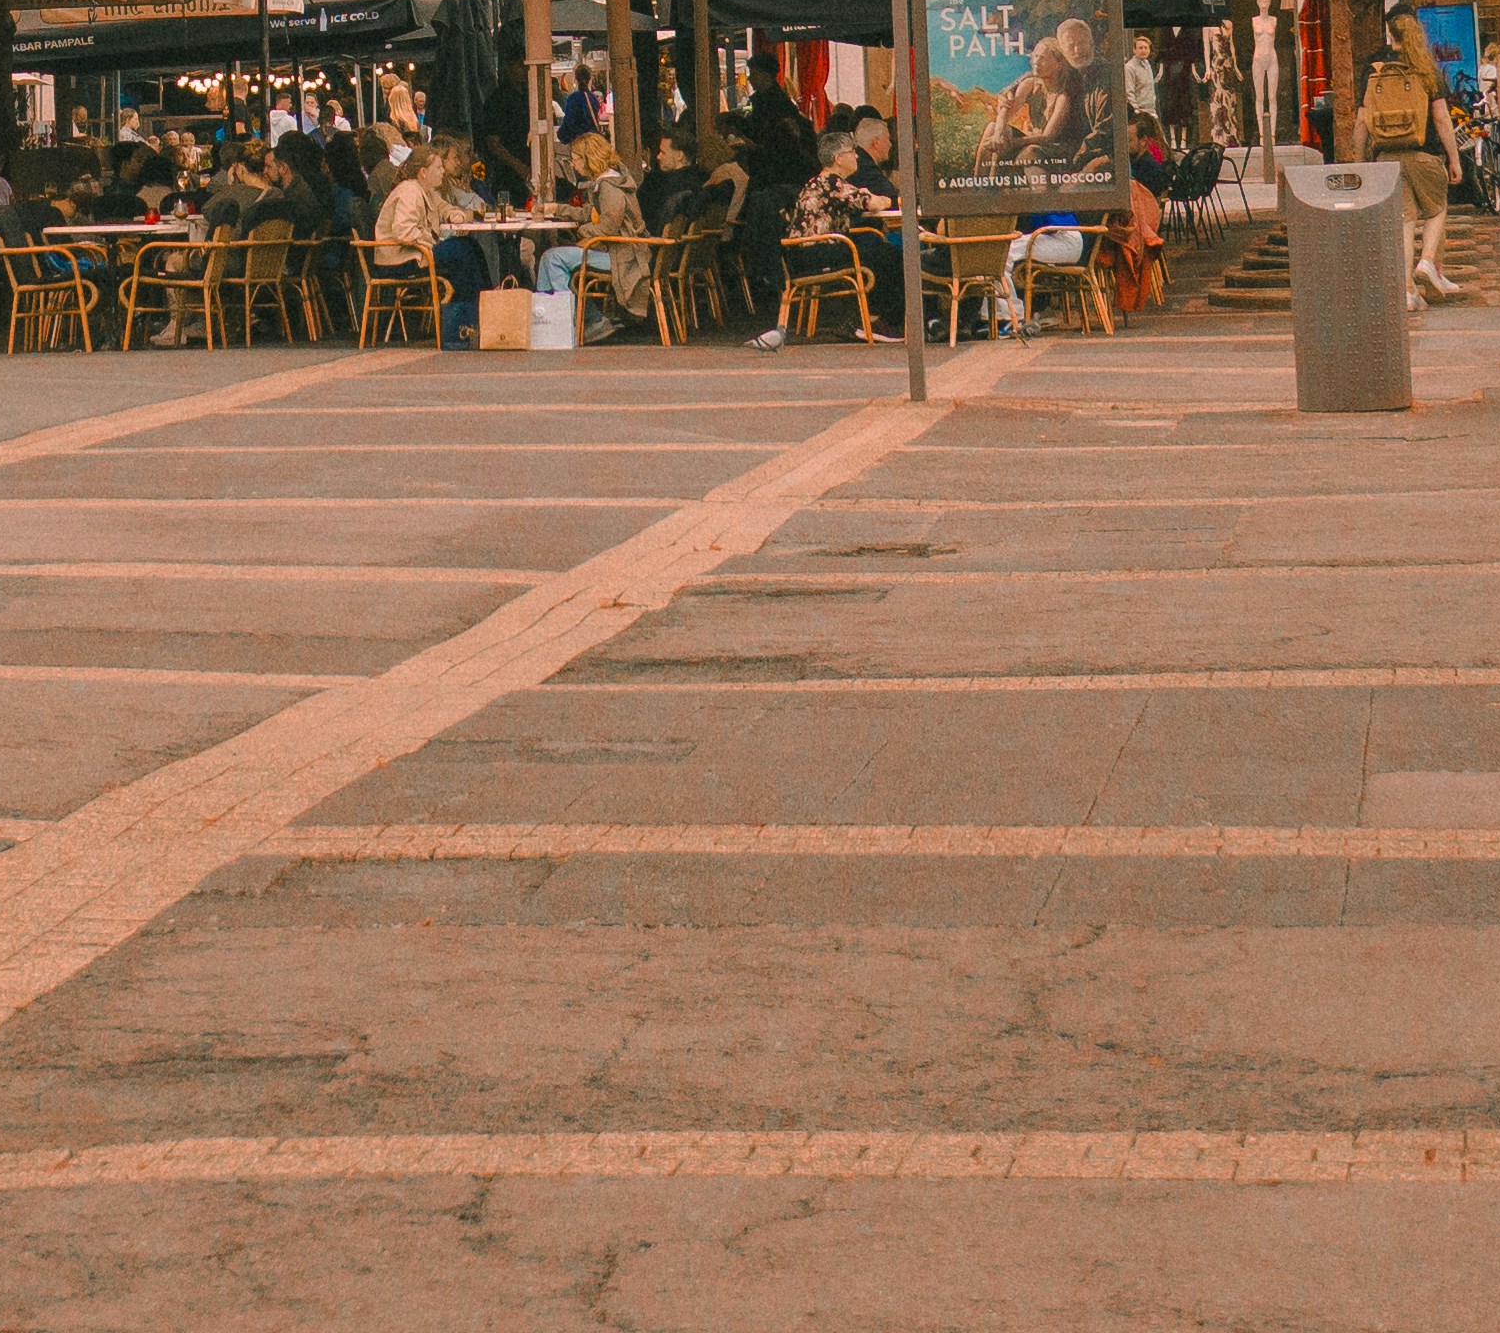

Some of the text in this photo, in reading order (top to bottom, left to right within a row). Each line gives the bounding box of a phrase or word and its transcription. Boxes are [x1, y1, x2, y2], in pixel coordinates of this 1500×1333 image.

[288, 17, 317, 27] serve
[330, 14, 348, 23] ICE
[349, 11, 380, 22] COLD
[939, 4, 1014, 32] SALT
[12, 41, 42, 53] KBAR
[949, 31, 1026, 58] PATH
[938, 178, 947, 189] 6
[949, 176, 1011, 188] AUGUSTUS
[1014, 176, 1027, 186] IN
[1031, 175, 1047, 185] DE
[1050, 172, 1112, 184] BIOSCOOP
